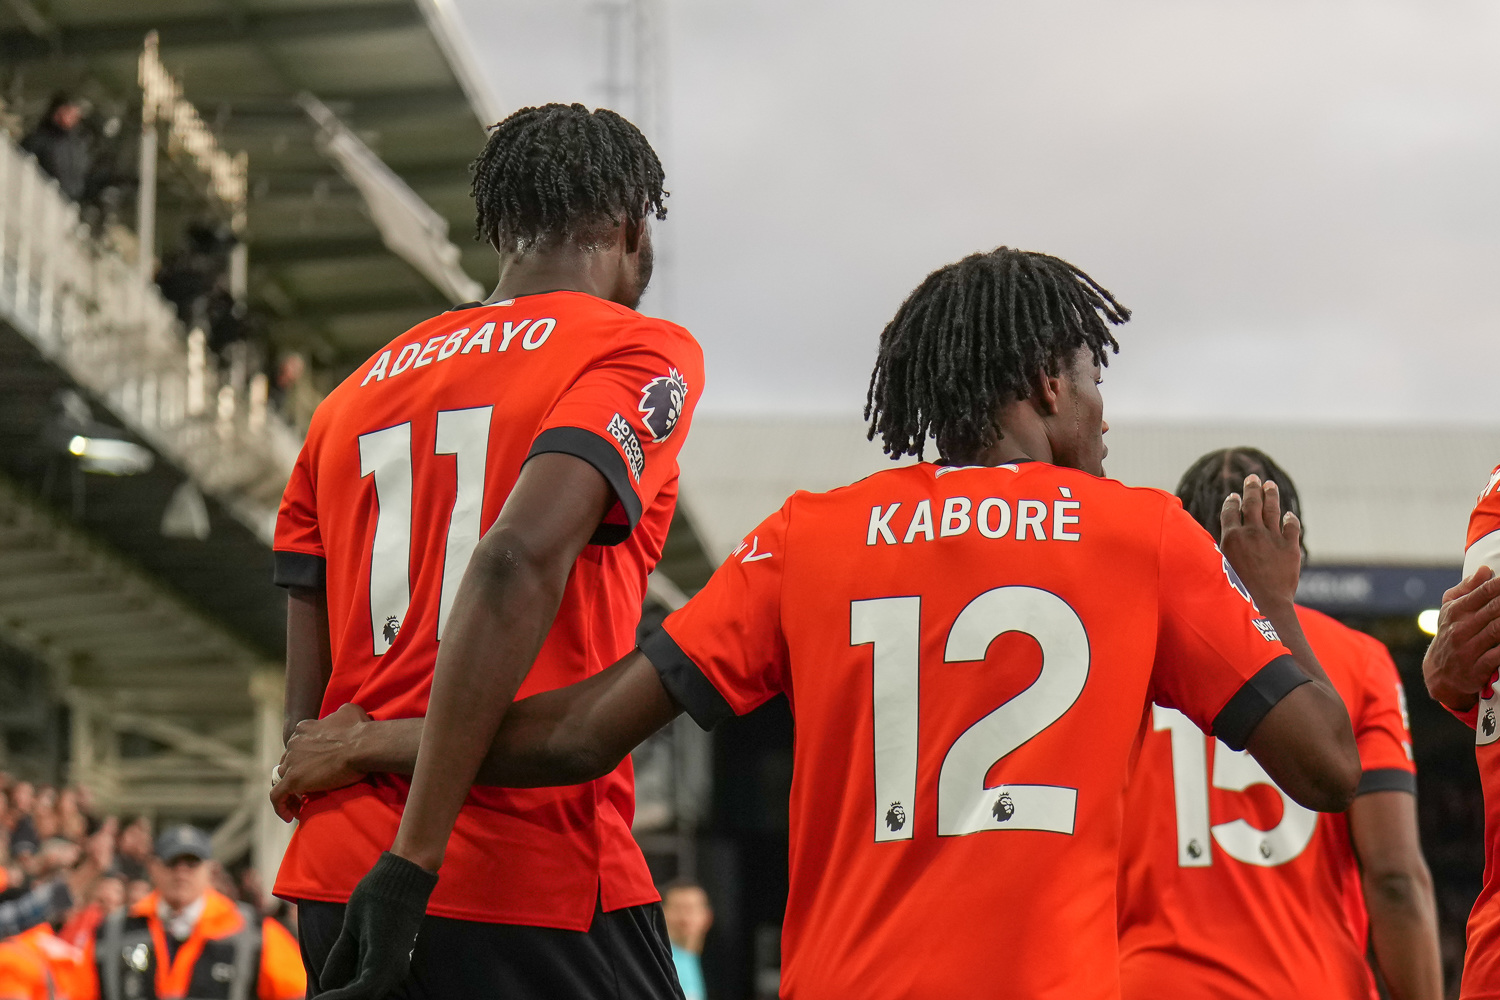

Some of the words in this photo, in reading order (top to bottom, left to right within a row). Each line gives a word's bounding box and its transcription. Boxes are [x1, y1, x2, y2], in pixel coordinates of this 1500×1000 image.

[360, 317, 557, 387] ADEBAYO
[358, 405, 494, 657] 11
[866, 486, 1081, 546] KABORÈ
[850, 585, 1091, 843] 12
[1152, 701, 1319, 868] 15
